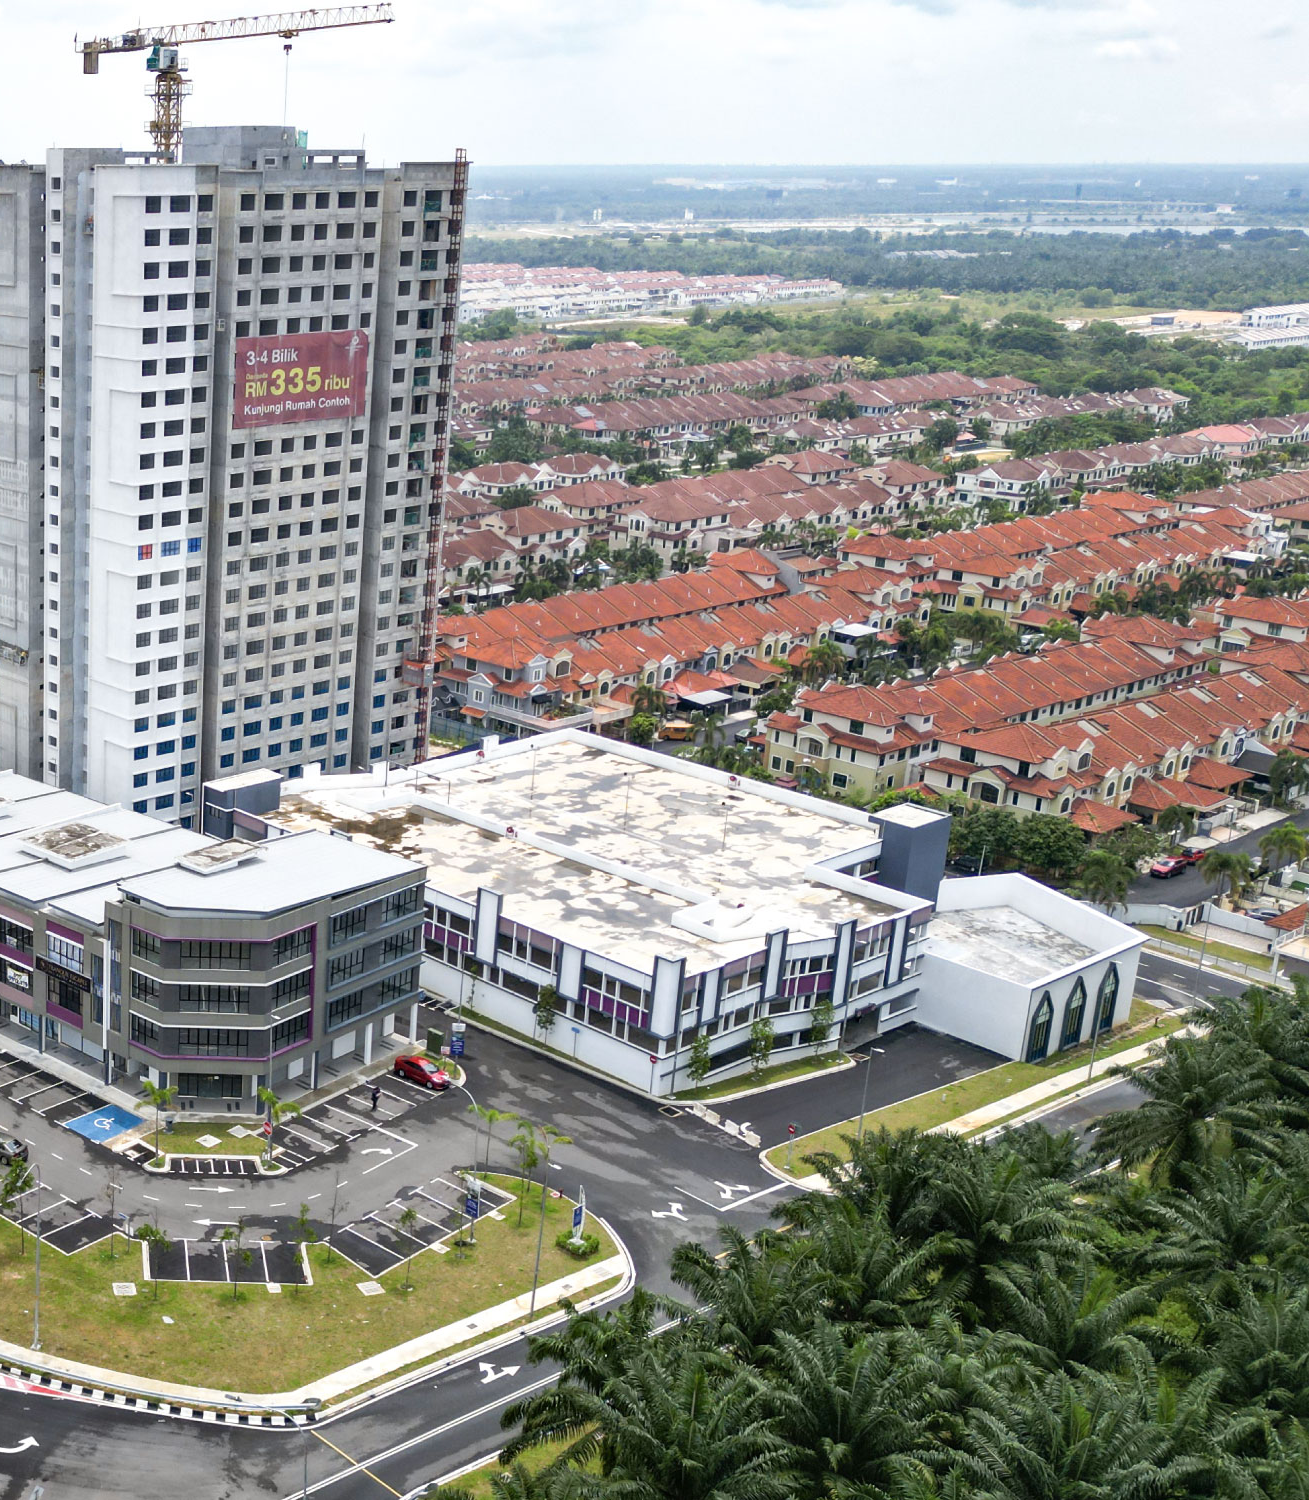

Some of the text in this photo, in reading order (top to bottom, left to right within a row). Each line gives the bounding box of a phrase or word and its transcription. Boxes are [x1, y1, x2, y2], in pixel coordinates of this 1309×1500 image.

[246, 348, 299, 366] 3-4 Bilik
[245, 380, 268, 398] RM
[270, 366, 322, 396] 335
[244, 395, 350, 416] Kunjungi Rumah Contoh
